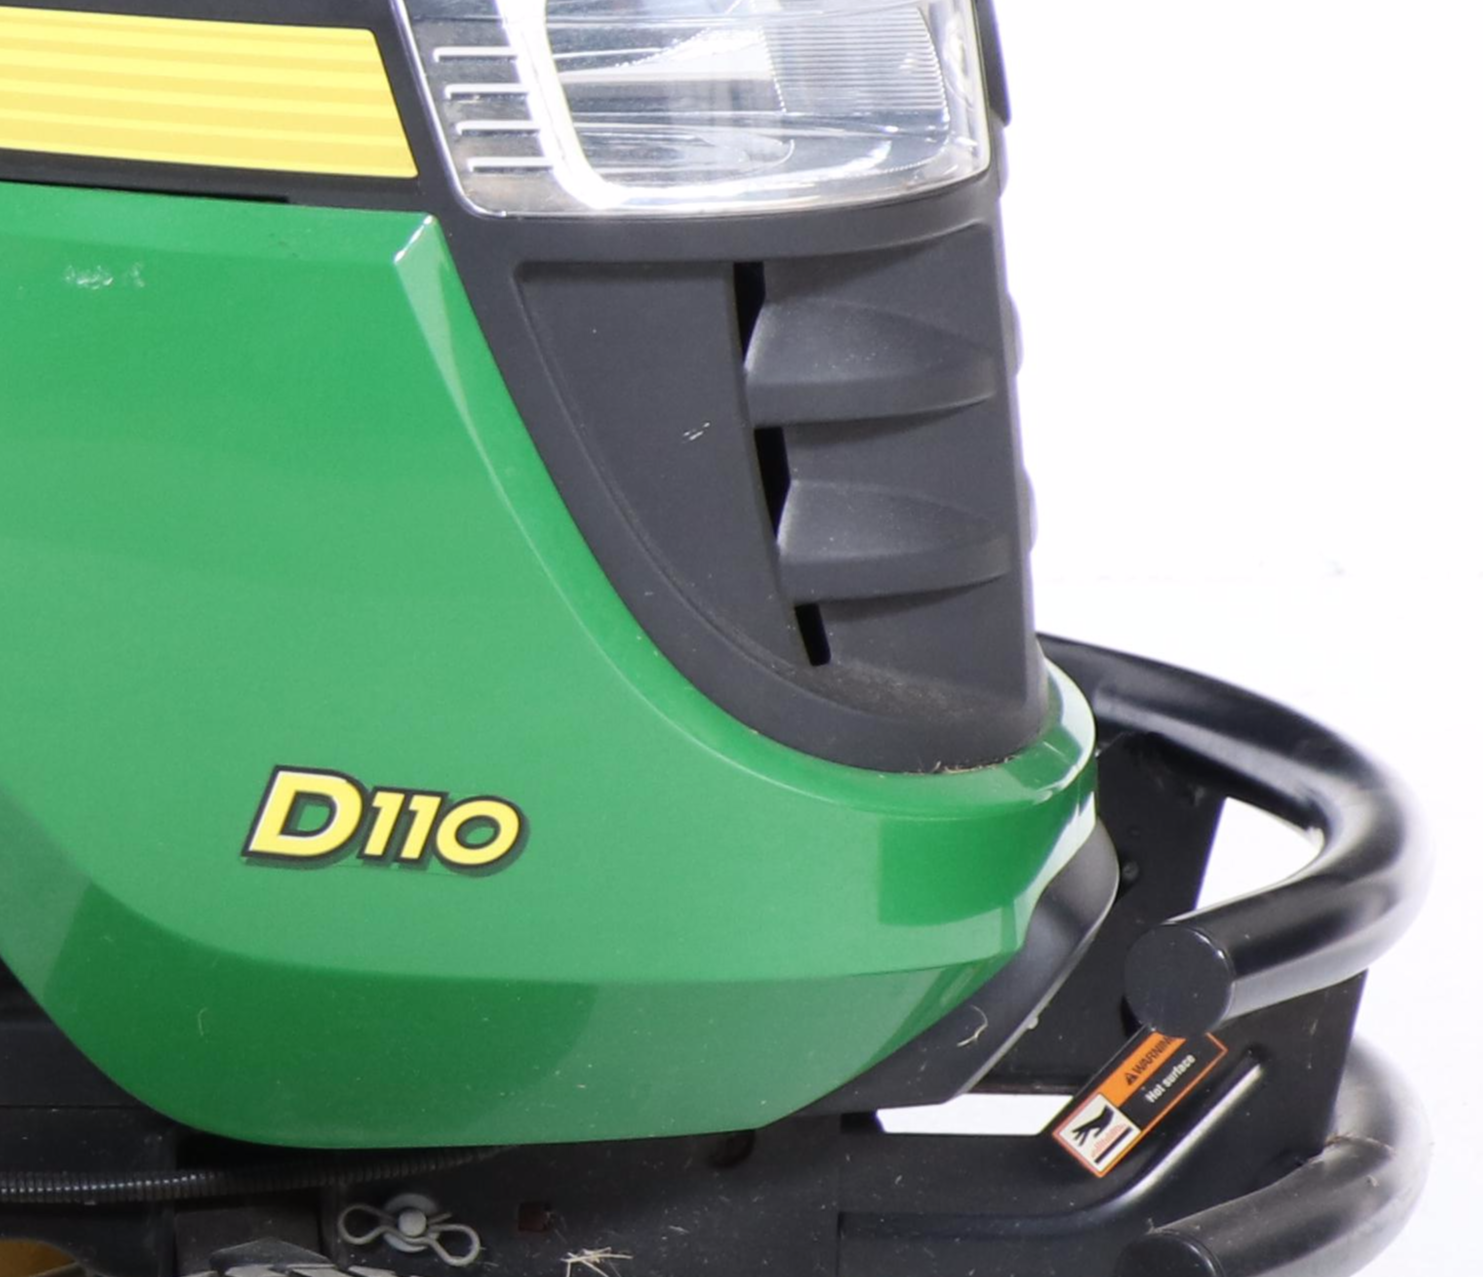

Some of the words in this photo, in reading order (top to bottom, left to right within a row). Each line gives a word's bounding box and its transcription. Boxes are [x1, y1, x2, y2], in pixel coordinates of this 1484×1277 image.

[242, 764, 525, 869] D110
[1131, 1035, 1173, 1074] WARNIN
[1144, 1083, 1166, 1103] Hot
[1162, 1054, 1196, 1088] surface
